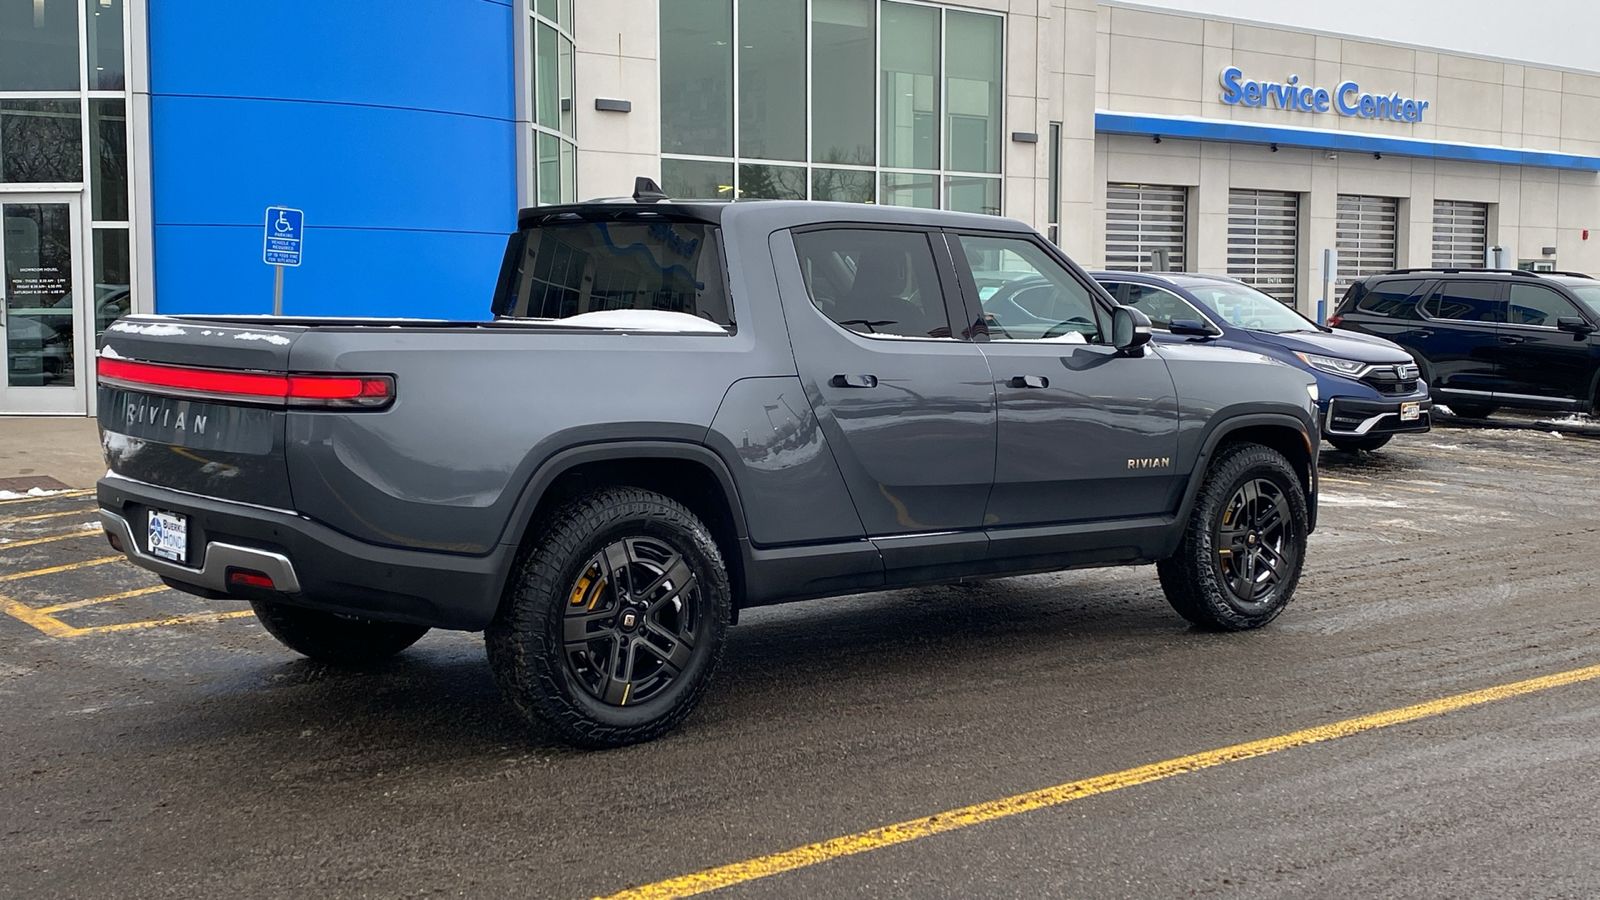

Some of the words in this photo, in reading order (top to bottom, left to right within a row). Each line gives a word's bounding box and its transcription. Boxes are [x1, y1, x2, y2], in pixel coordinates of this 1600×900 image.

[1219, 65, 1330, 114] Service
[1333, 80, 1430, 123] Center
[126, 403, 208, 435] RIVIAN
[1127, 457, 1170, 469] RIVIAN
